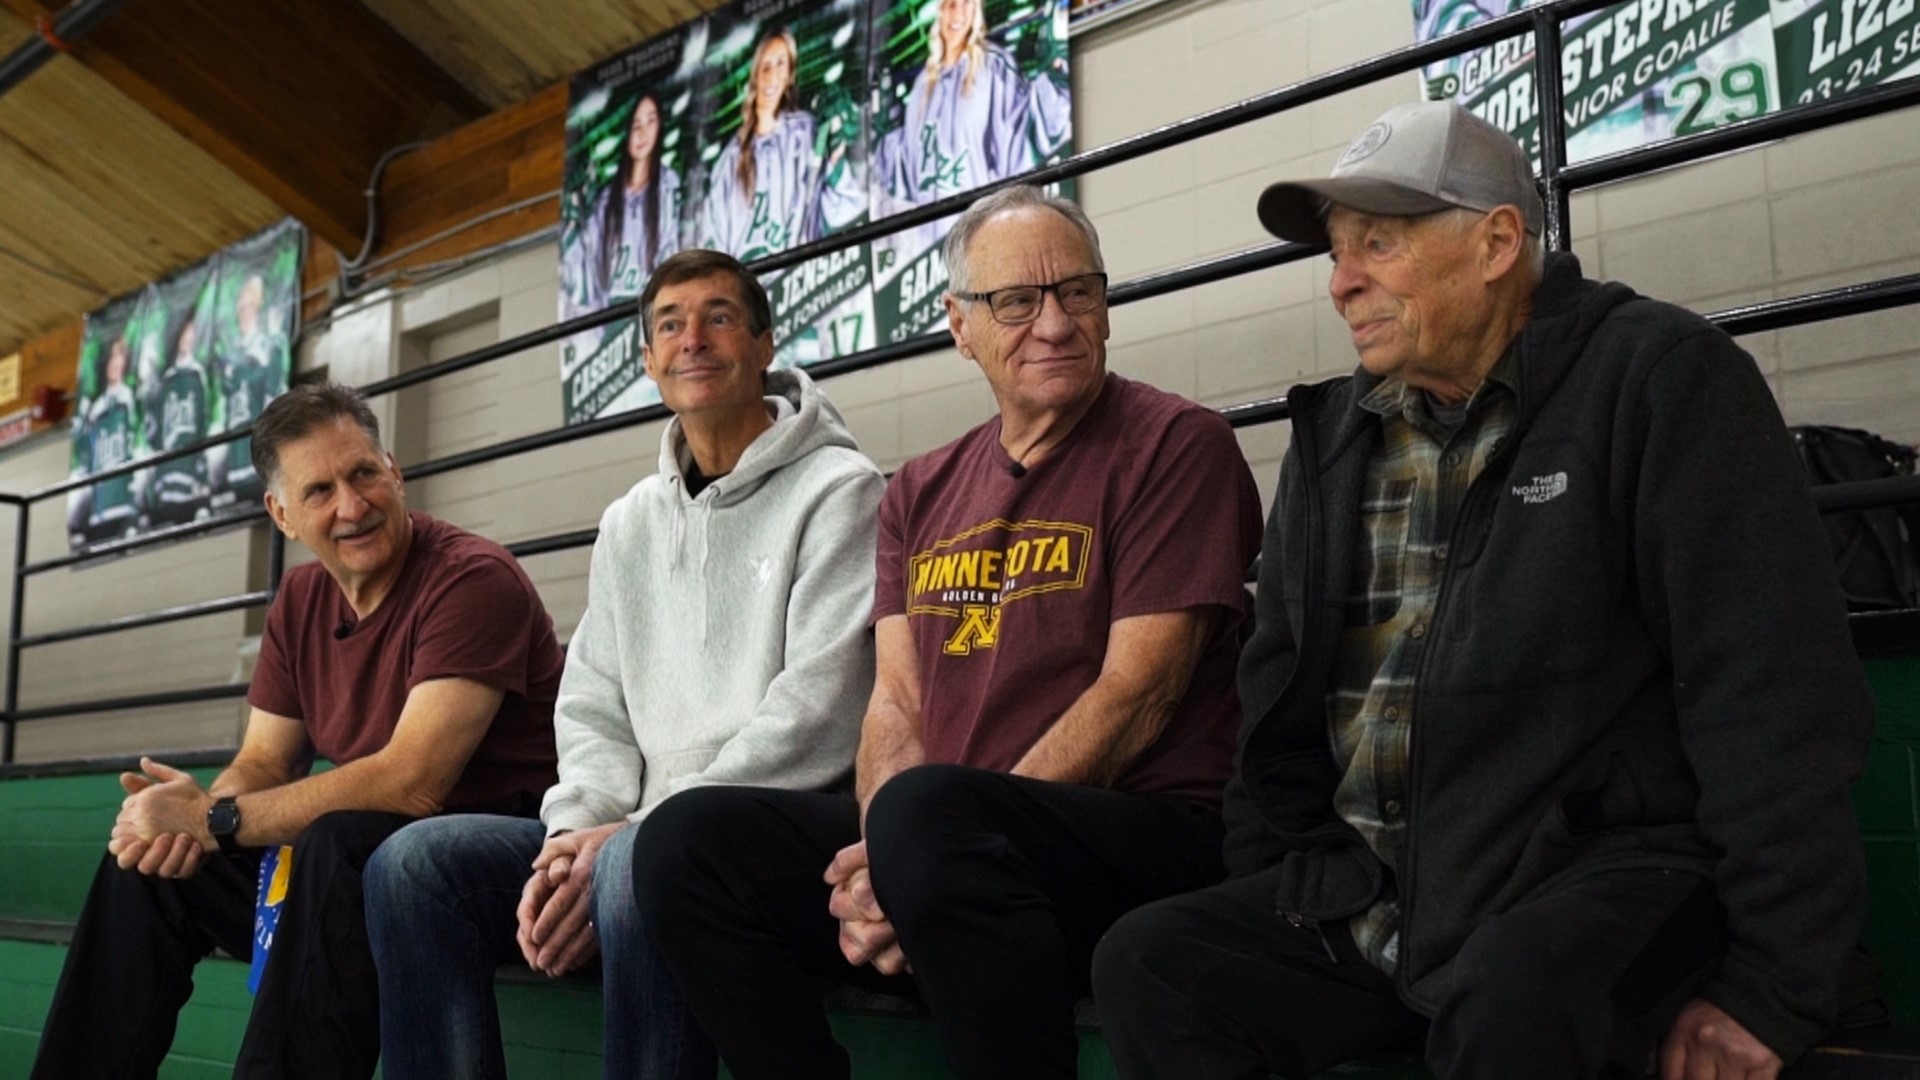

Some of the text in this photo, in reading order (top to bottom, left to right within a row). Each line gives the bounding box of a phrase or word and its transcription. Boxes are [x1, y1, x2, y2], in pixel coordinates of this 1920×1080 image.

[1633, 1, 1736, 86] GOALIE
[1668, 61, 1768, 137] 29
[793, 264, 867, 331] FORWARD
[829, 312, 863, 359] 17
[572, 322, 636, 409] CASSIDY
[1512, 485, 1554, 496] NORTH
[1523, 491, 1551, 504] FACE
[1532, 475, 1554, 486] THE
[915, 536, 1070, 598] MINNEOTA
[942, 589, 985, 602] GOLDEN
